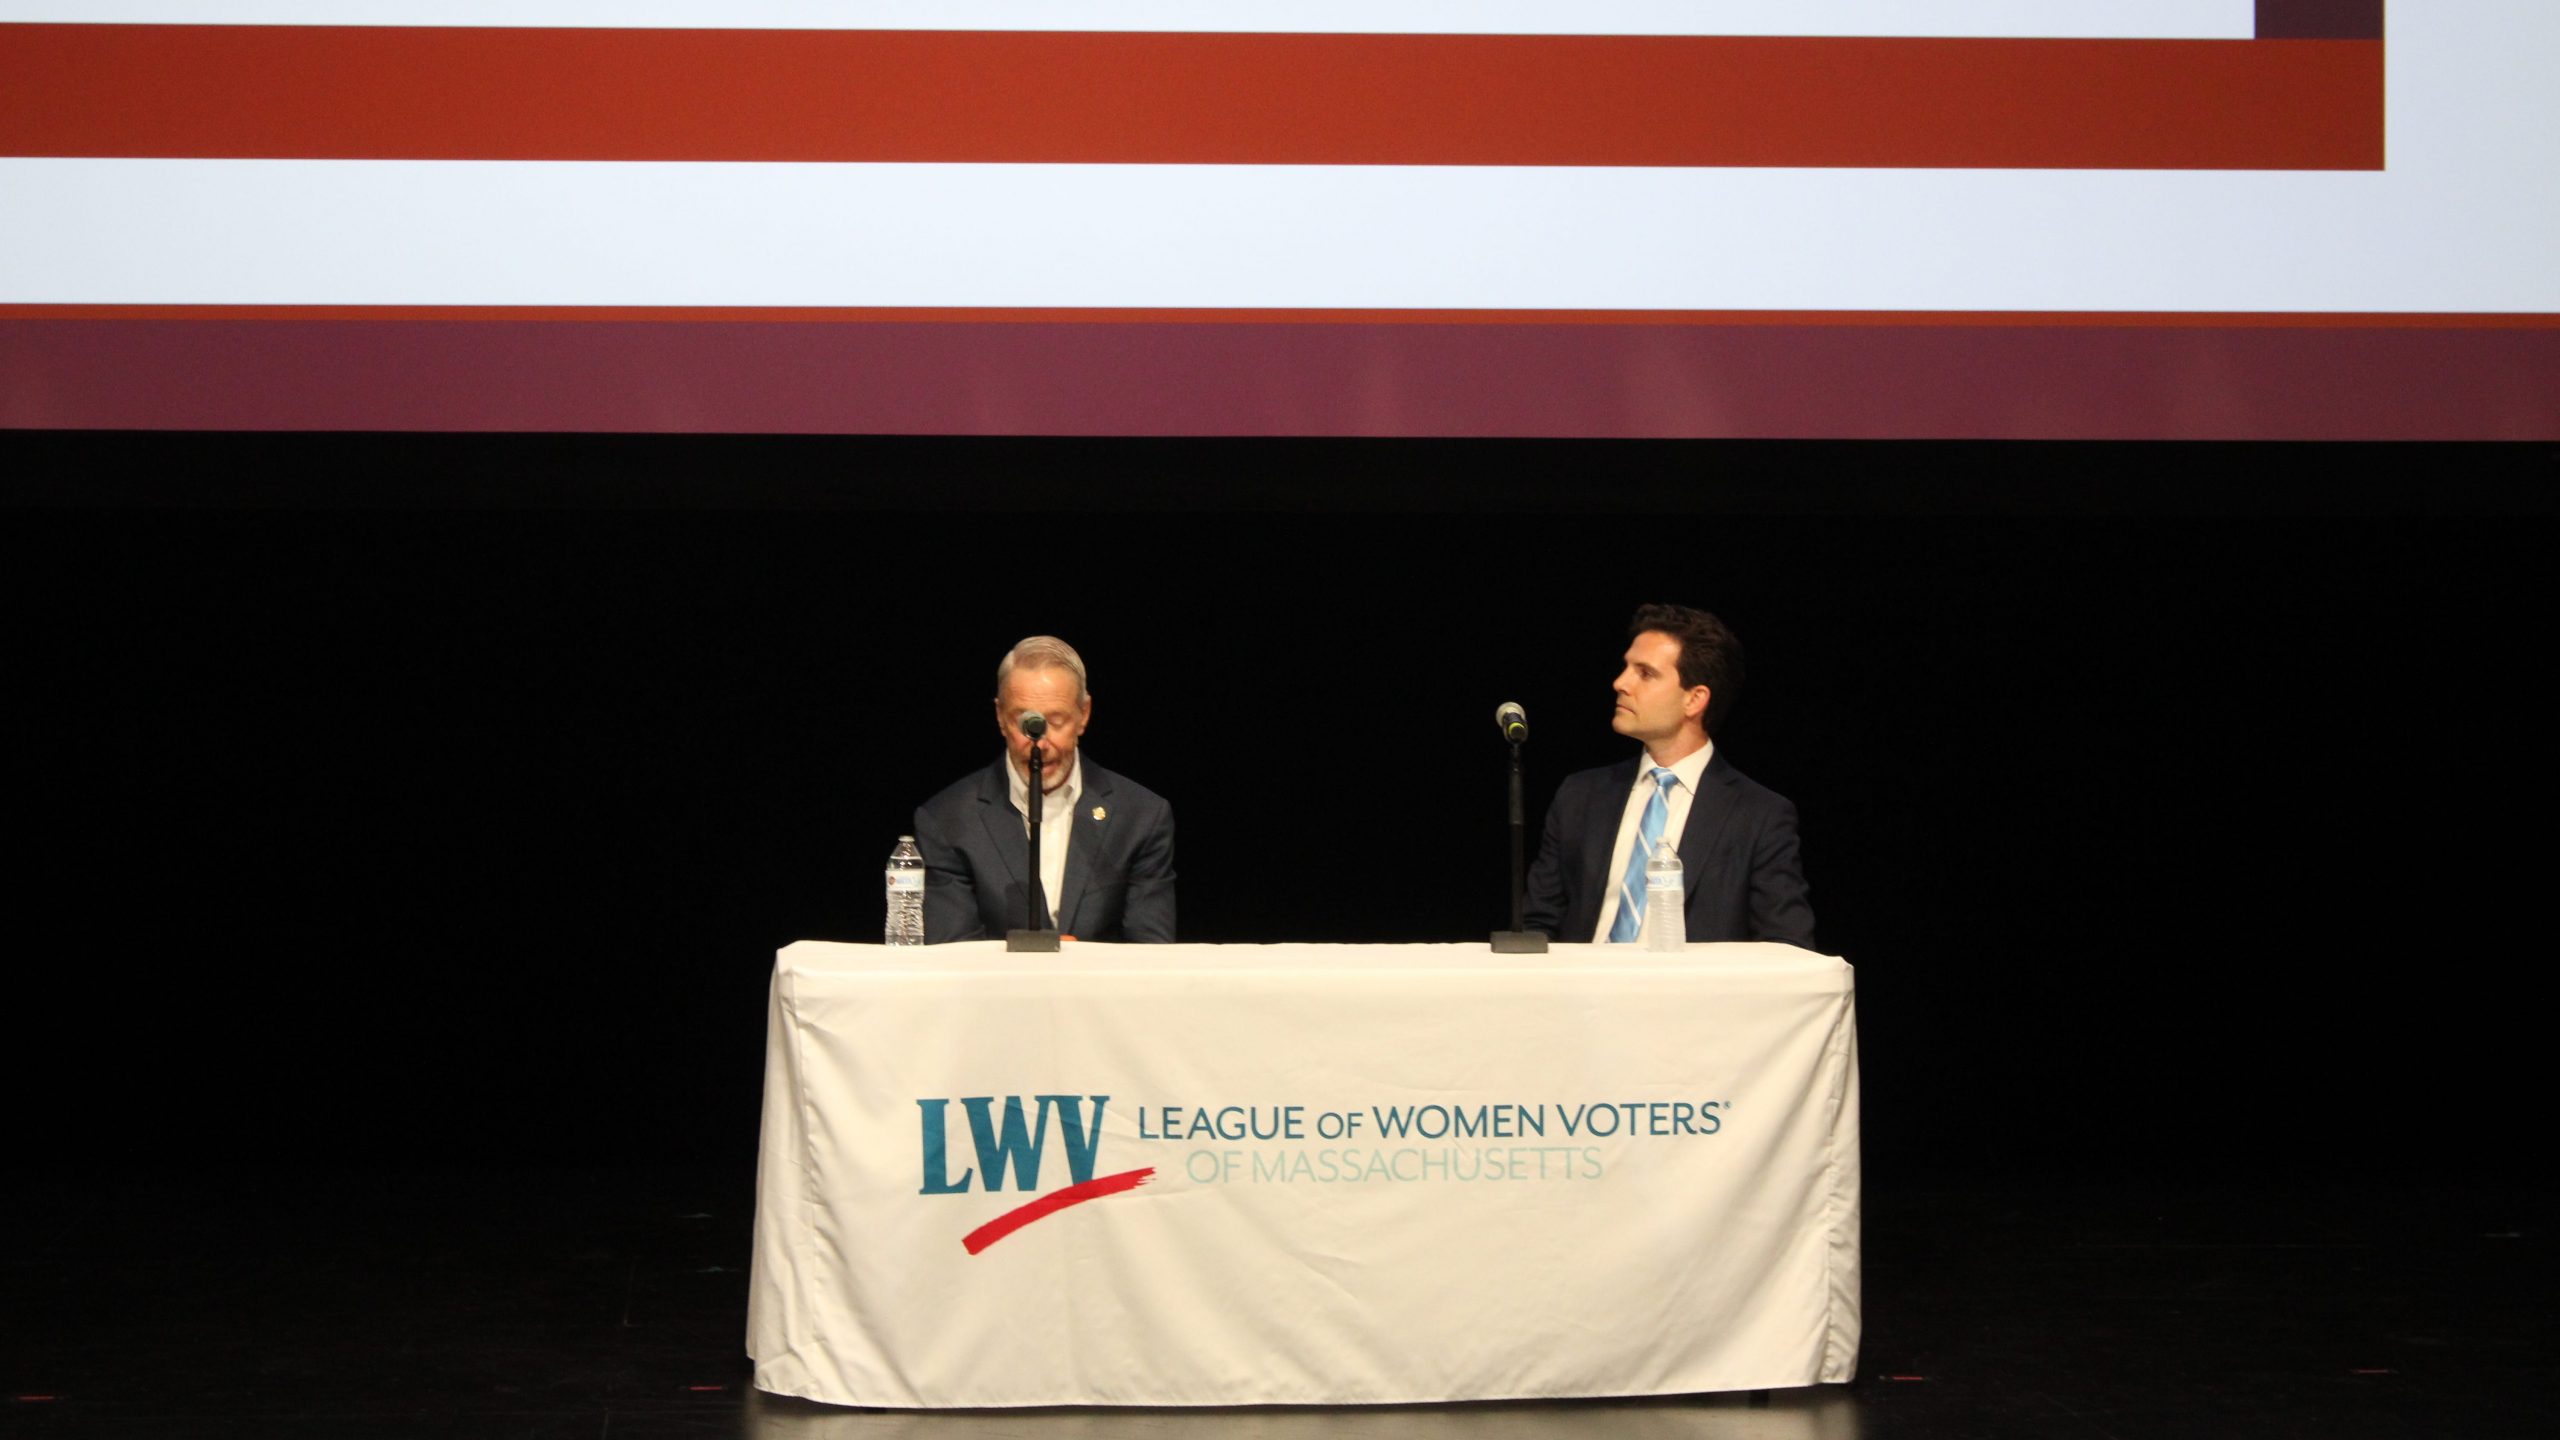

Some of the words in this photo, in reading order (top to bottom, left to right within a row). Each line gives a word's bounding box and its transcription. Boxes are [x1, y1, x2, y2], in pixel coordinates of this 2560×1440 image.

[1139, 1106, 1305, 1140] LEAGUE
[1317, 1112, 1363, 1139] OF
[1372, 1104, 1545, 1139] WOMEN
[916, 1095, 1110, 1195] LWV
[1186, 1149, 1242, 1184] OF
[1252, 1146, 1603, 1183] MASSACHUSETTS
